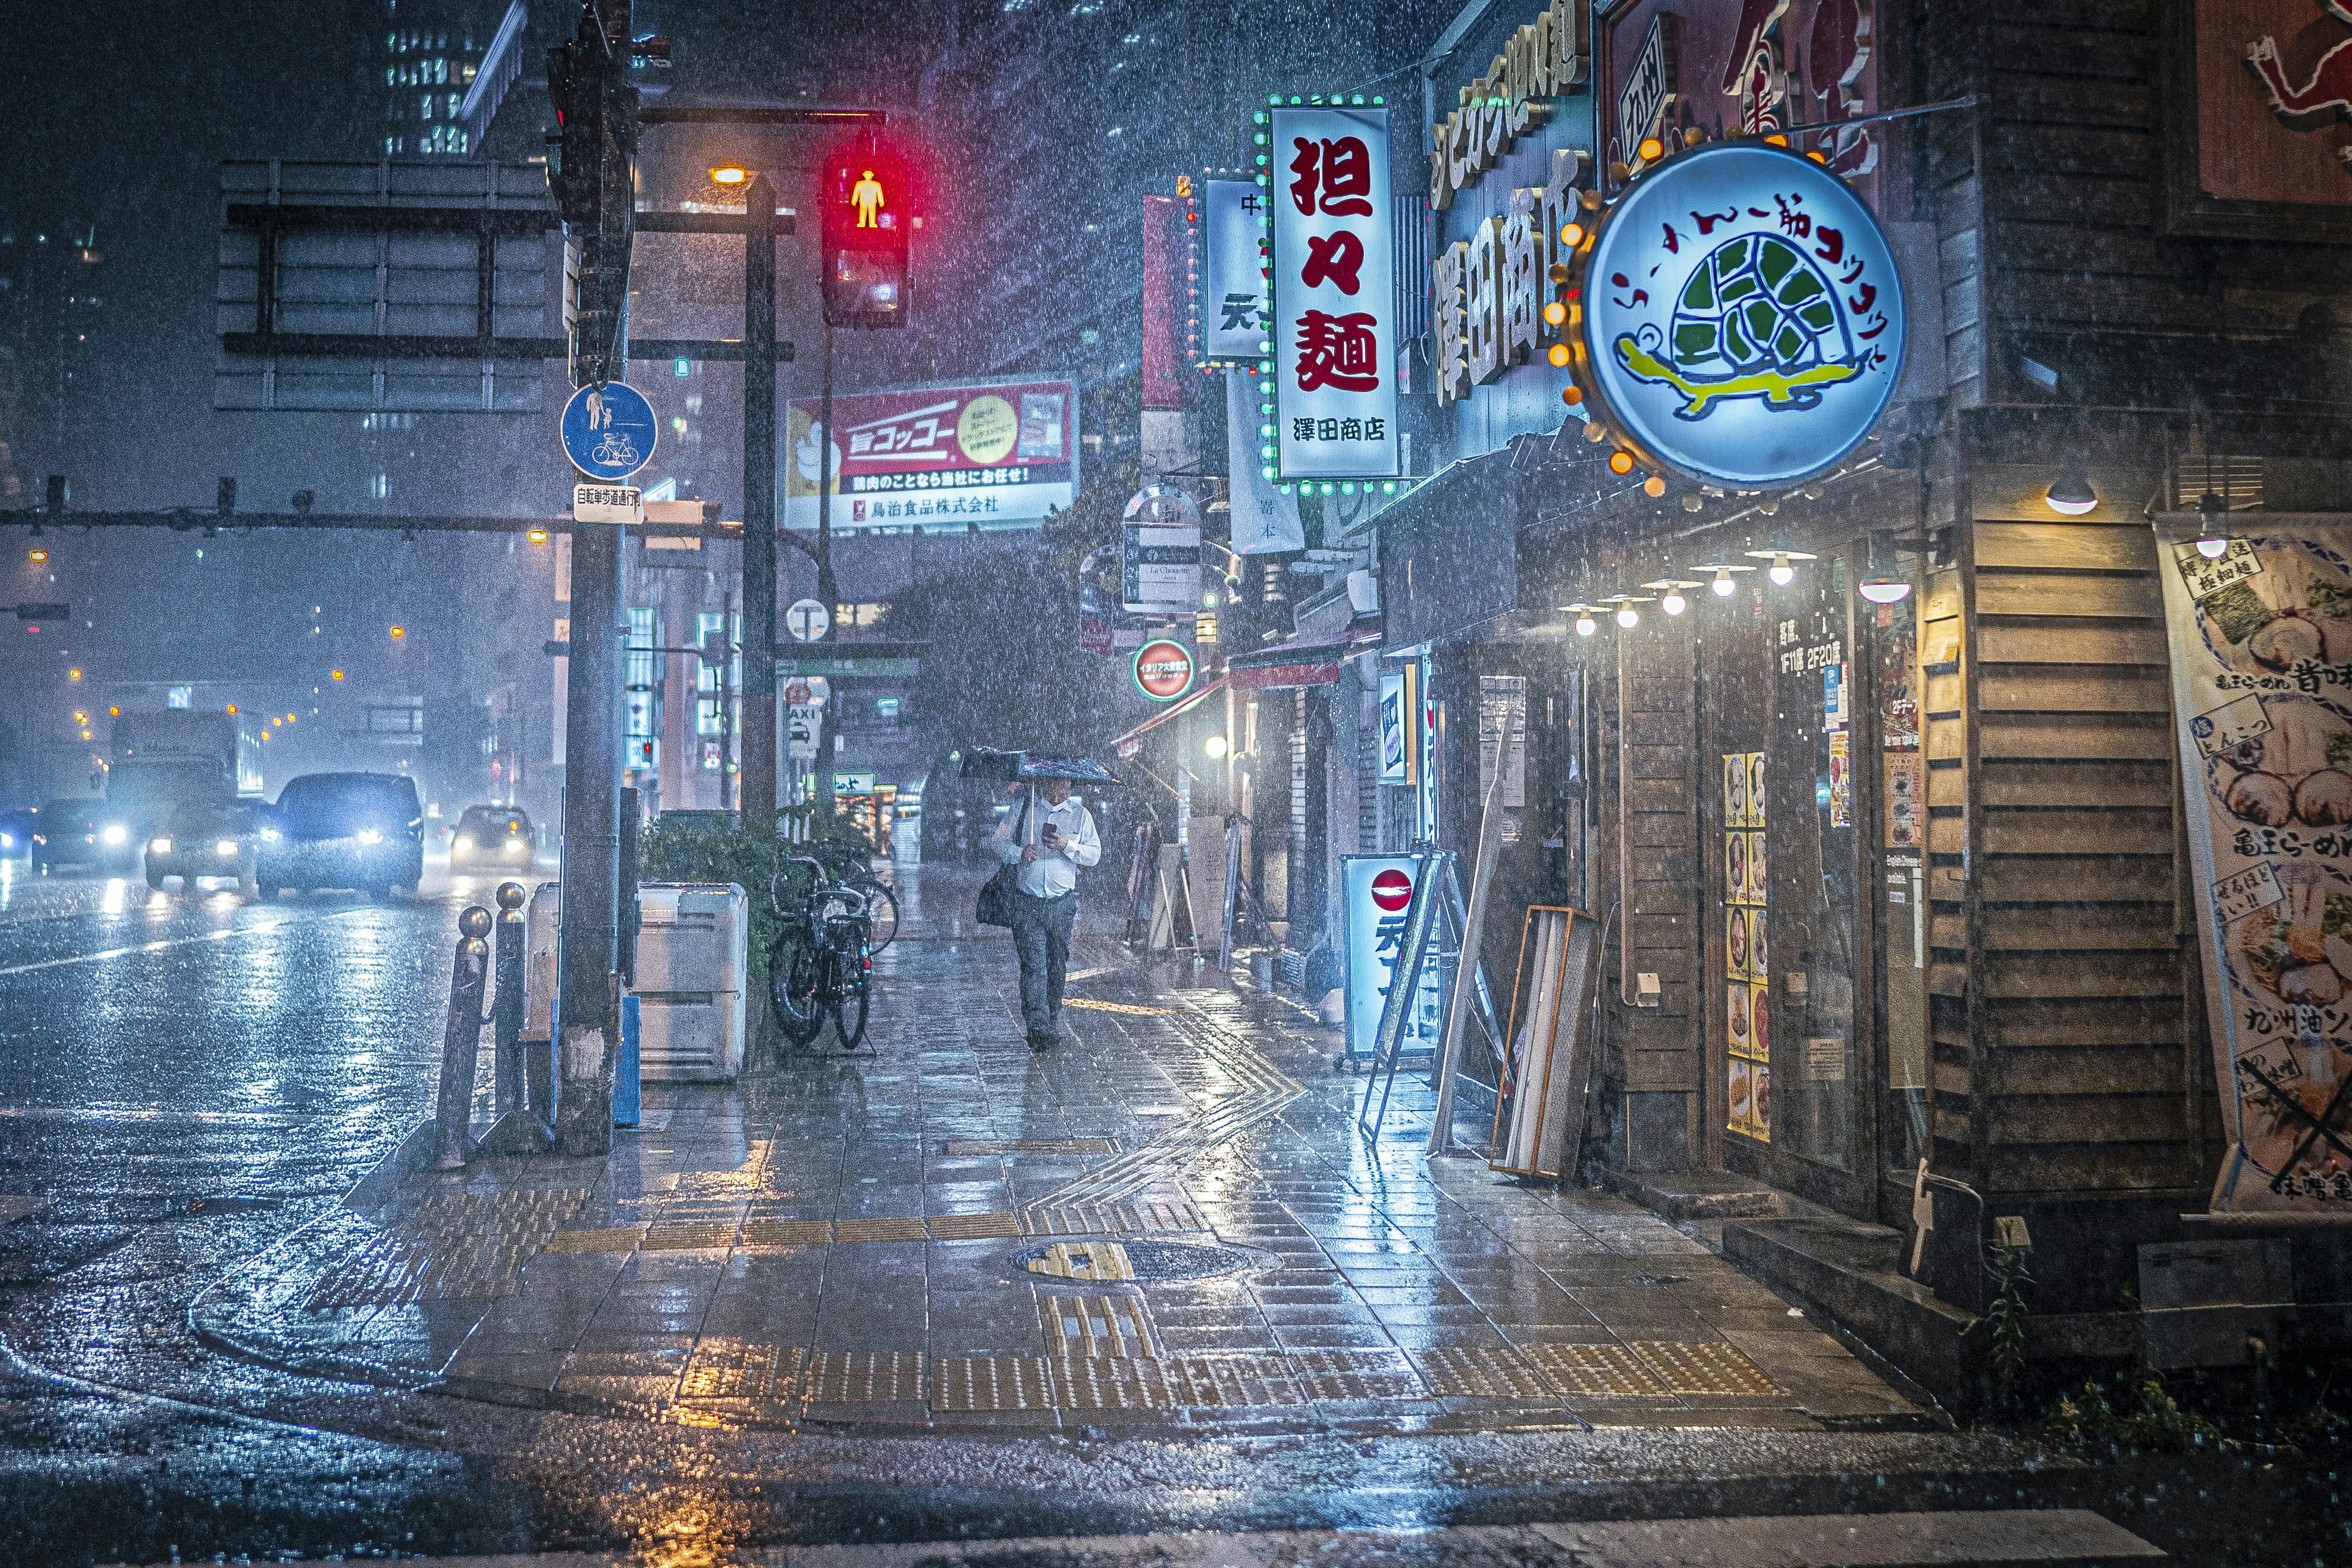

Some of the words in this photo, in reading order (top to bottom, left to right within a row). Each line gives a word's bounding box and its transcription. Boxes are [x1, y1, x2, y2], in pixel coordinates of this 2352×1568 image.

[1288, 136, 1379, 393] 担々麺
[1293, 417, 1385, 443] 澤田商店
[852, 467, 1028, 492] 鶏肉のことなら当社にお任せ!
[871, 497, 999, 518] 鳥治食品株式会社
[1807, 640, 1840, 670] 2F20席
[789, 708, 816, 720] AXI
[2244, 1007, 2352, 1034] 九州油ソ
